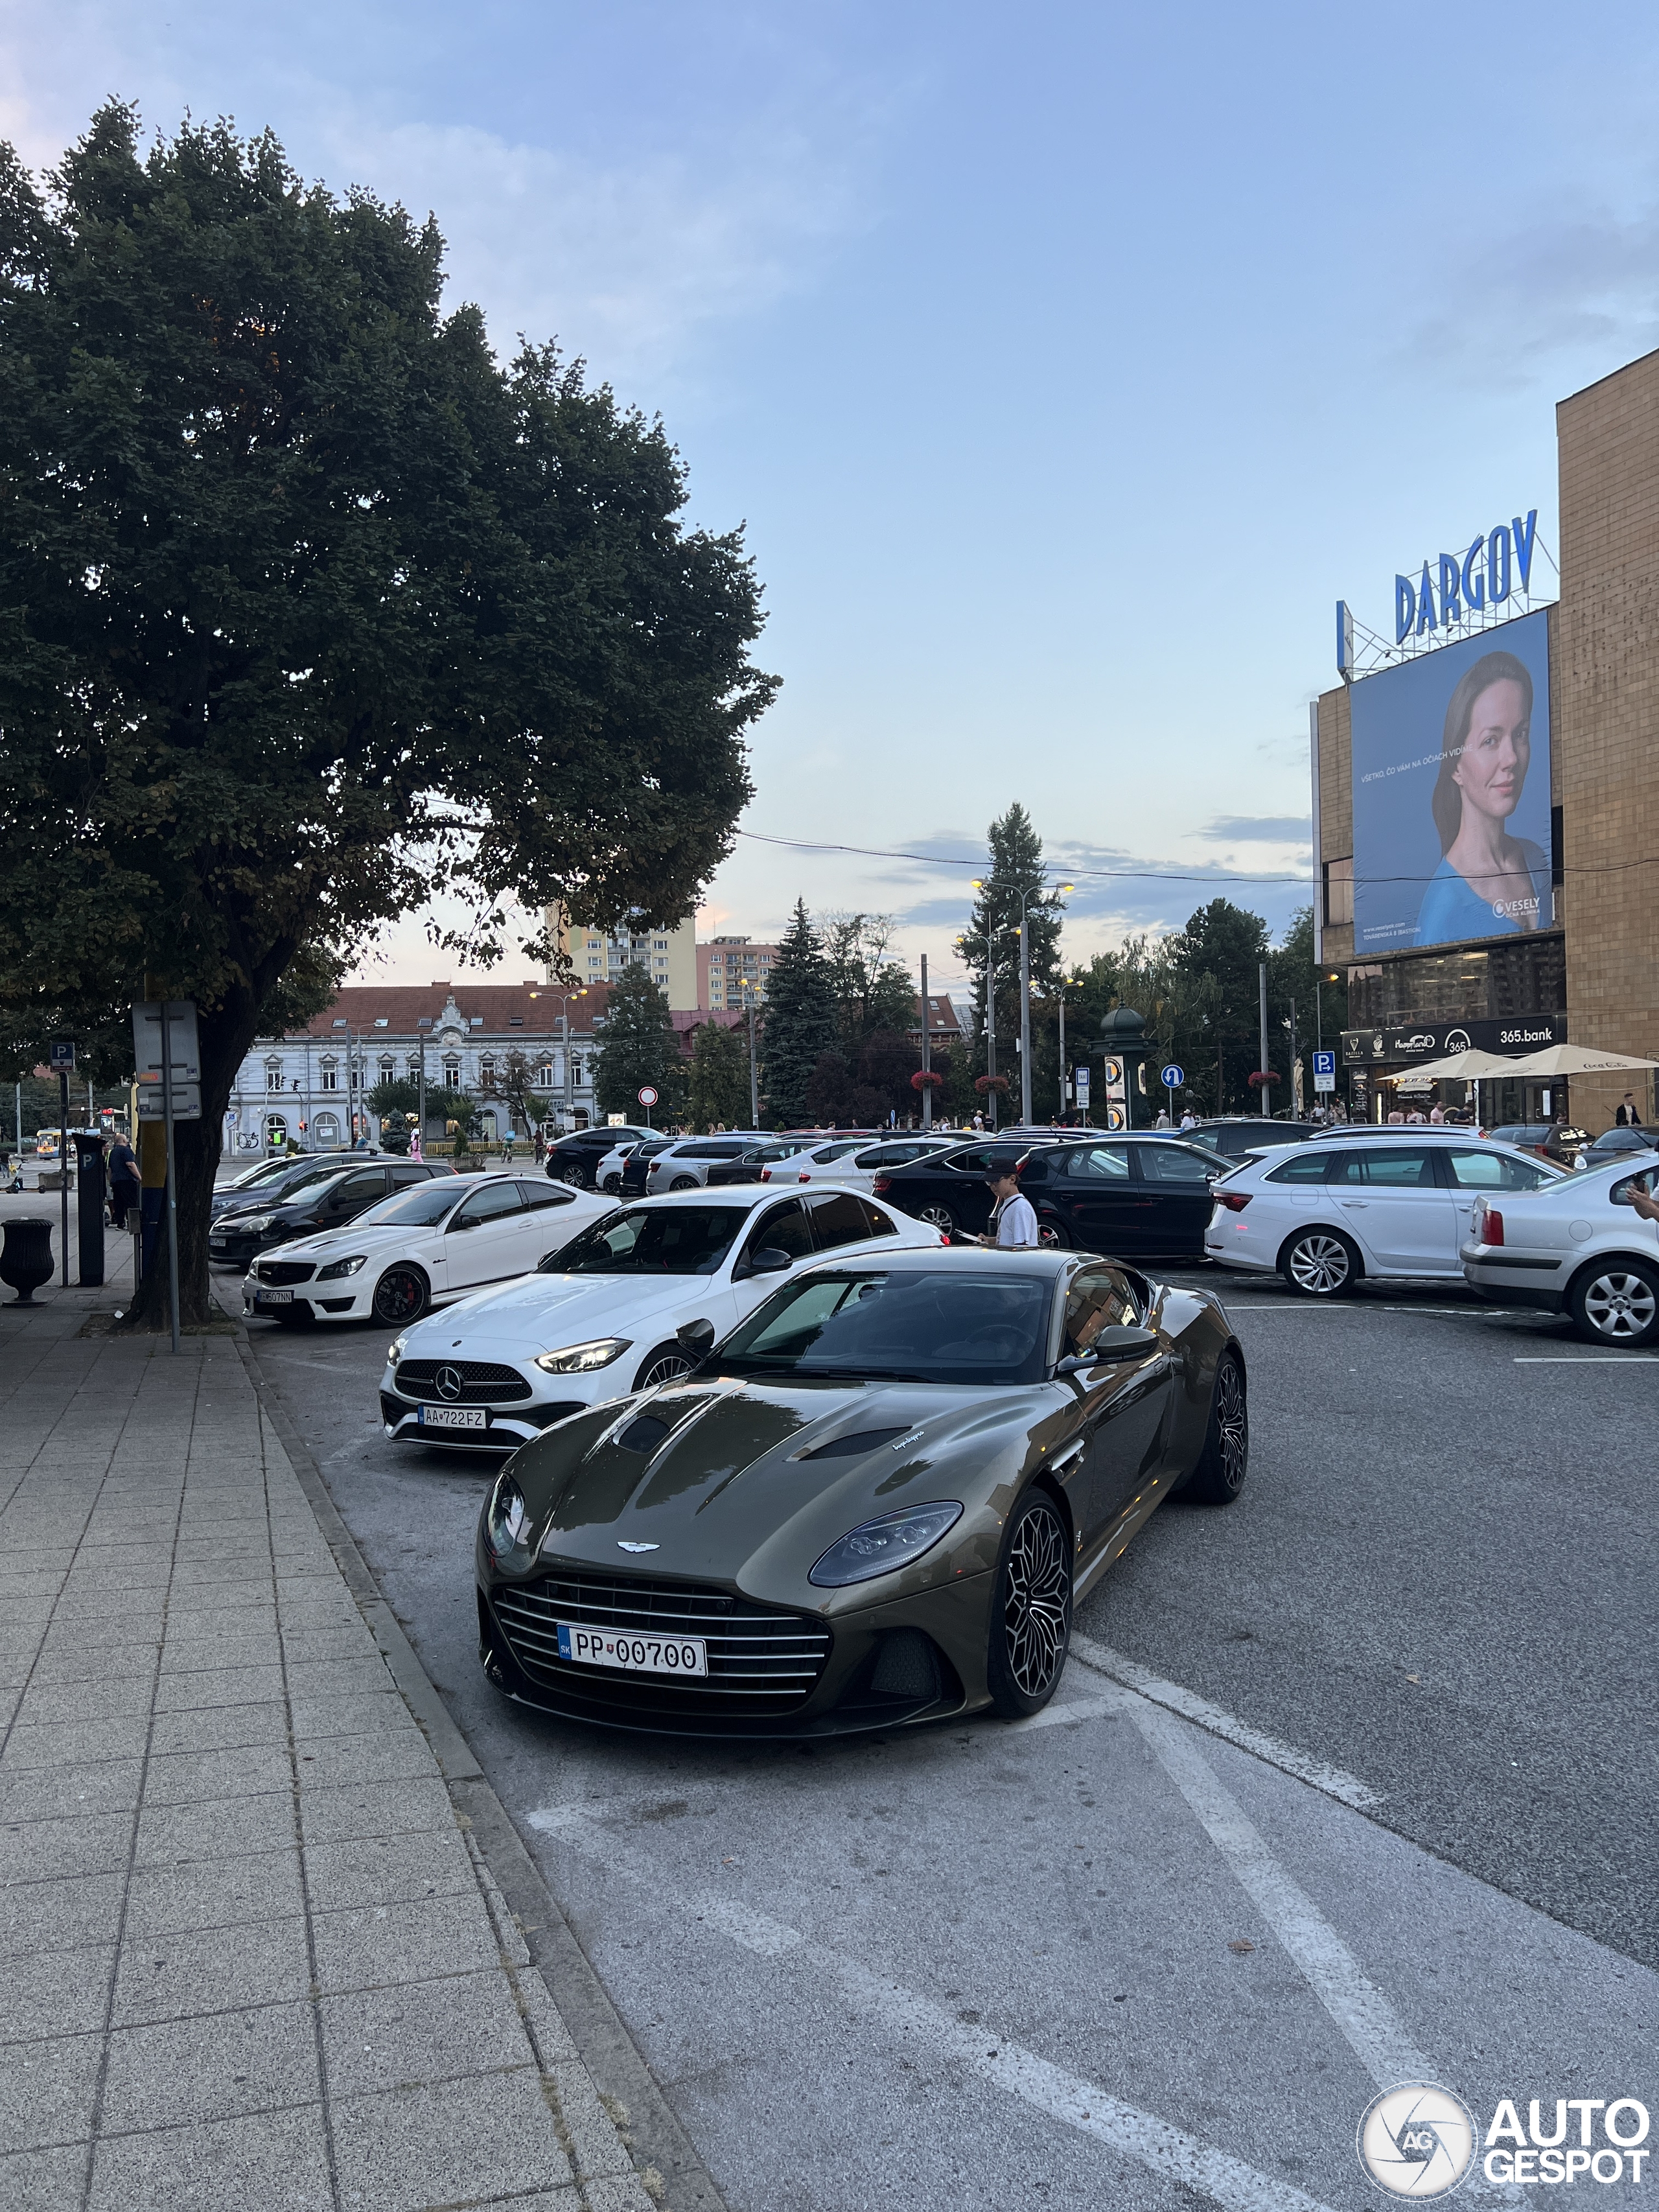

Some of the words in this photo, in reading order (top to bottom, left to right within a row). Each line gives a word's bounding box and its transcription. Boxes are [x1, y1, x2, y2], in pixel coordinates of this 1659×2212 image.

[1395, 509, 1538, 645] DARGOV
[1361, 771, 1386, 783] VŠETKO,
[1386, 767, 1395, 775] ČO
[1397, 763, 1410, 772] VÁM
[1412, 760, 1421, 768] NA
[1422, 752, 1448, 765] OČIACH
[1449, 744, 1473, 757] VIDÍME
[1500, 1027, 1553, 1043] 365.bank
[57, 1045, 67, 1058] P
[1449, 1042, 1466, 1053] 365
[1318, 1054, 1330, 1072] P
[83, 1154, 92, 1167] P
[426, 1409, 439, 1423] AA
[443, 1411, 482, 1426] 722FZ
[561, 1645, 570, 1655] SK
[576, 1633, 603, 1659] PP
[616, 1639, 696, 1669] 00700
